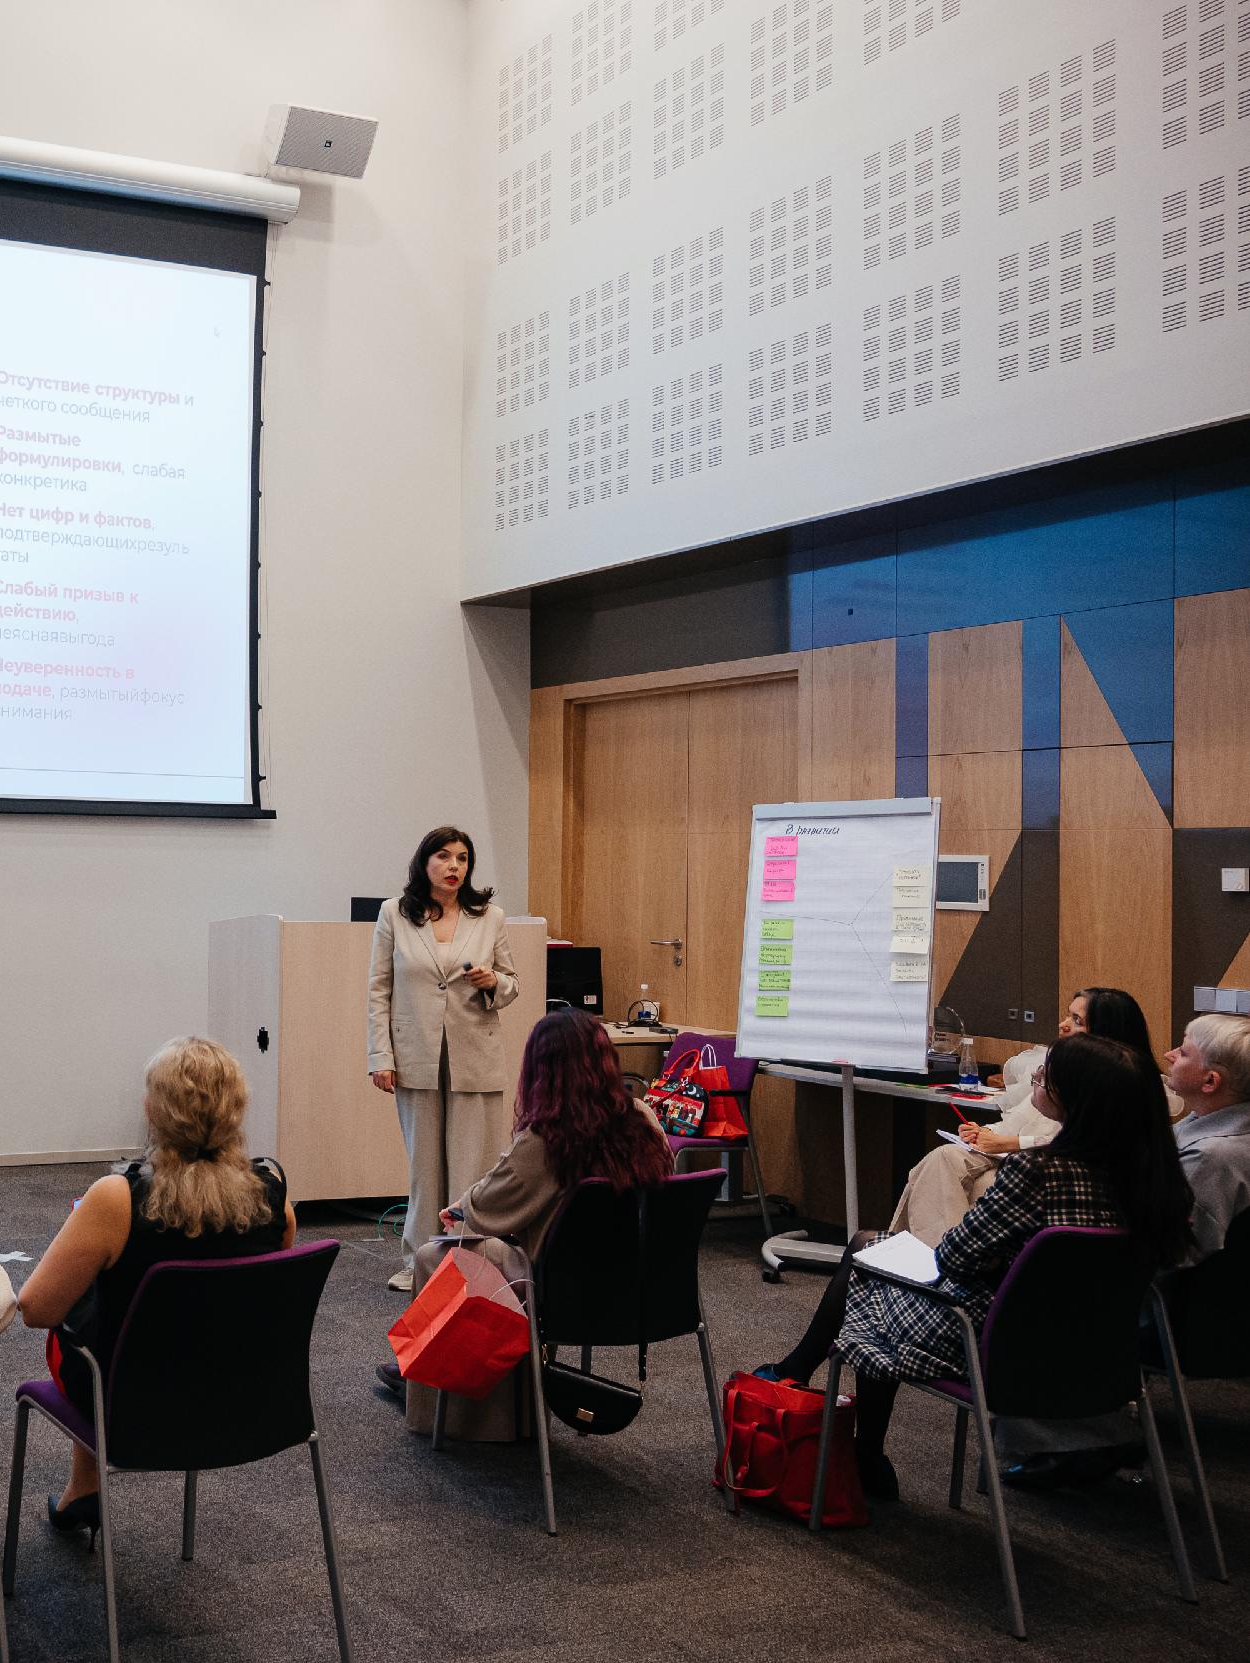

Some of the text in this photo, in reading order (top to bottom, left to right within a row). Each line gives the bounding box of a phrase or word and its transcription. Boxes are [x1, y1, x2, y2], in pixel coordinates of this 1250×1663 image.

[95, 384, 181, 406] структуры
[184, 394, 194, 407] и
[60, 401, 150, 424] сообщения
[132, 463, 185, 480] слабая
[29, 503, 75, 526] цифр
[78, 511, 90, 525] и
[61, 587, 125, 604] призыв
[129, 592, 139, 605] к
[125, 668, 135, 680] в
